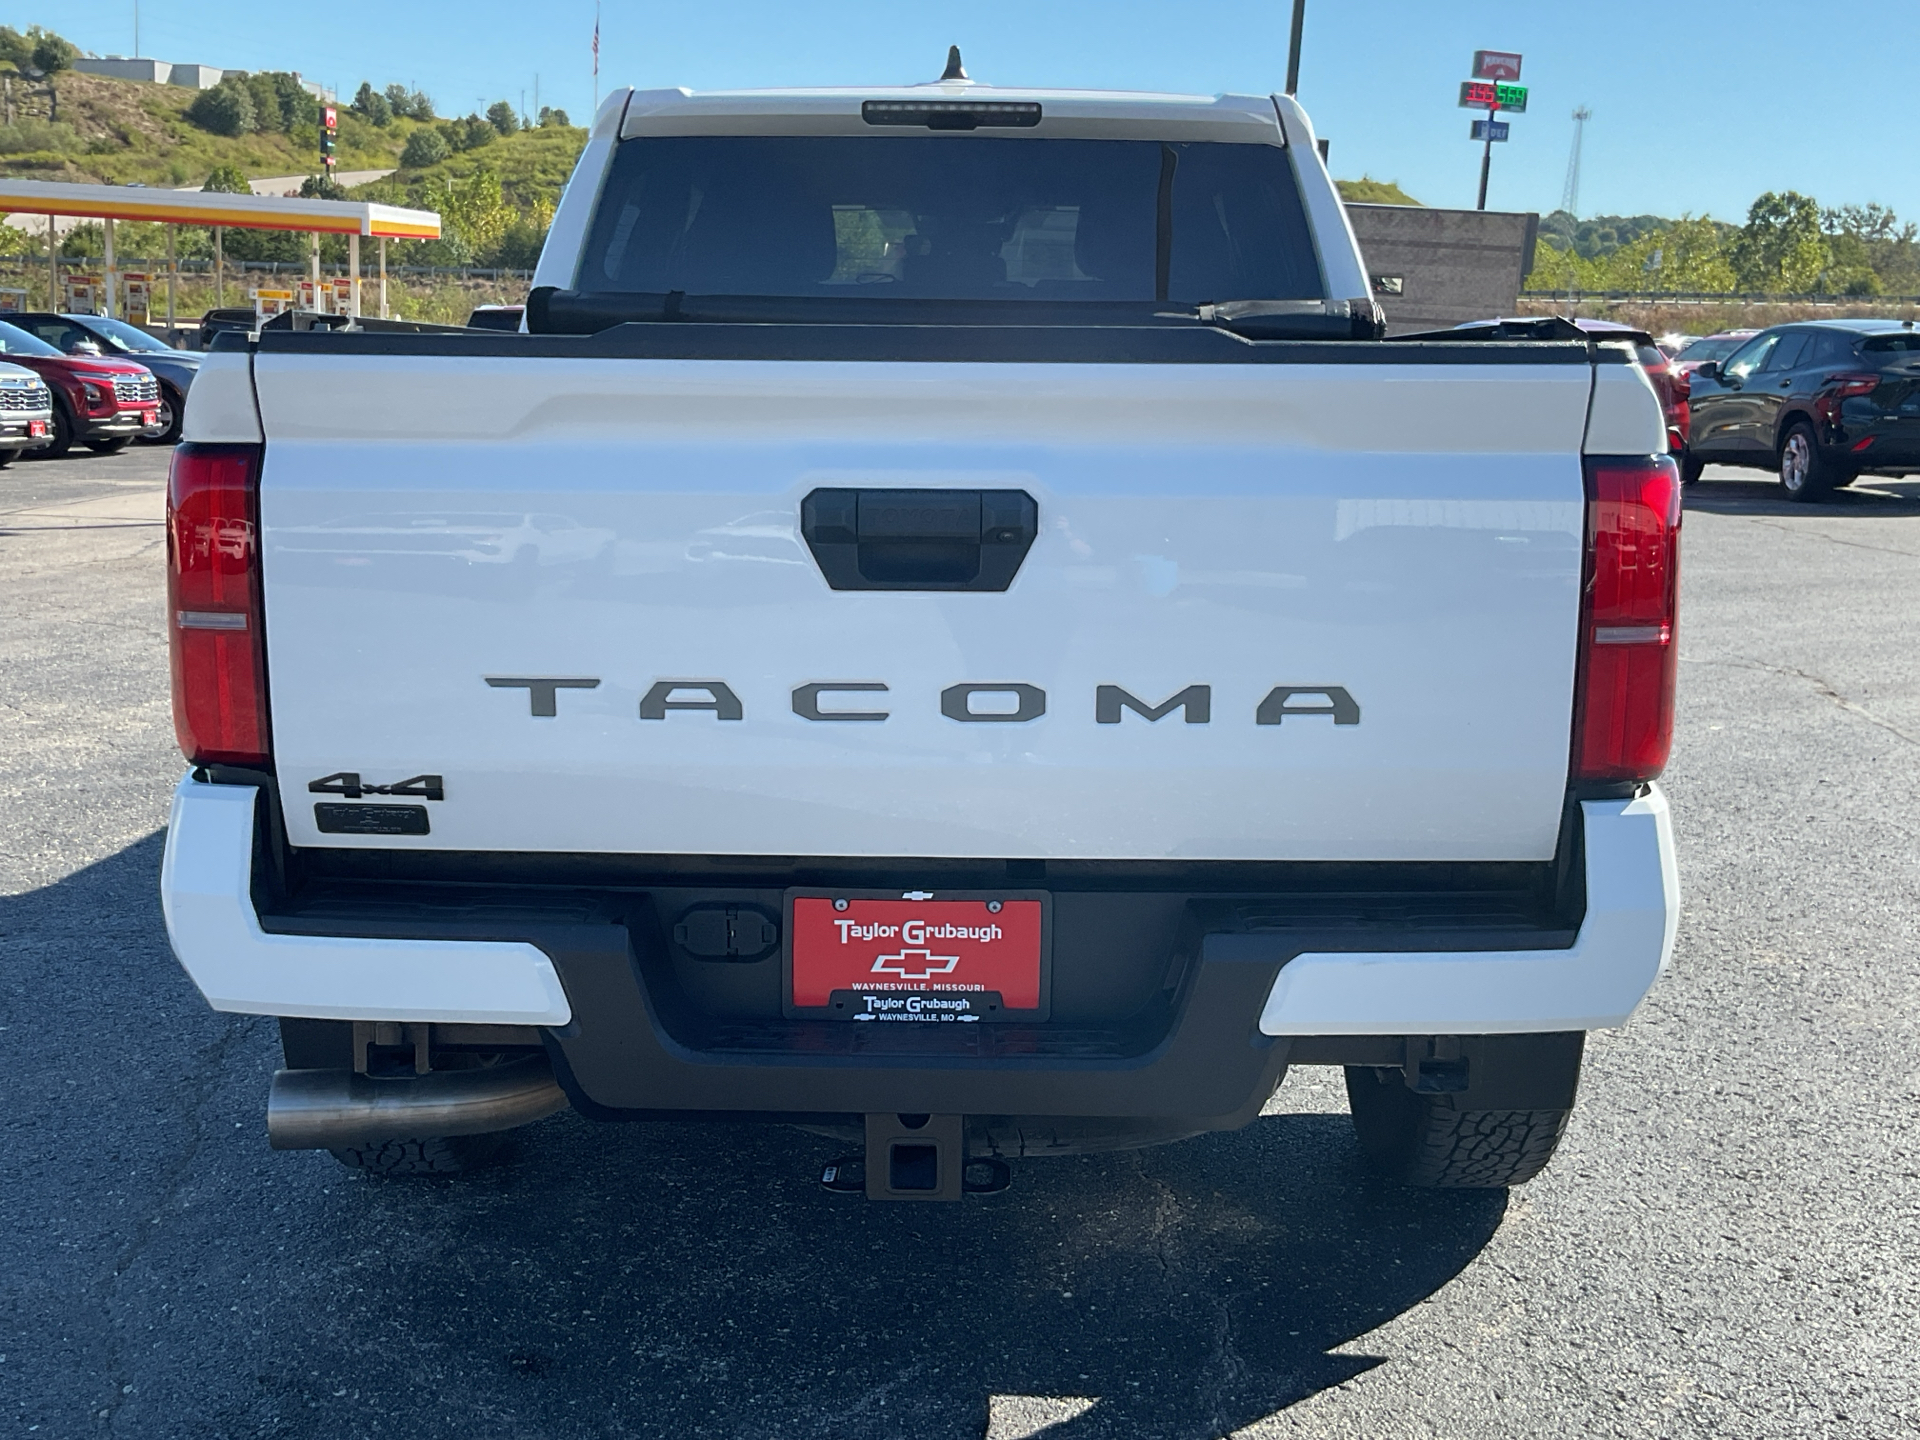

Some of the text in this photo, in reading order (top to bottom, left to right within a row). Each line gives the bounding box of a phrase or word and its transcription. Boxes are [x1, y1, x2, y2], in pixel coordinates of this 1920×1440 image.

[865, 508, 974, 526] TOYOTA
[485, 677, 1360, 726] TACOMA
[307, 772, 444, 801] 4x4
[833, 919, 1002, 945] Taylor Grubaugh
[852, 982, 985, 992] WAYNESVILLE, MISSOURI
[862, 995, 970, 1012] Taylor Grubaugh
[878, 1013, 954, 1022] WAYNESVILLE, MO
